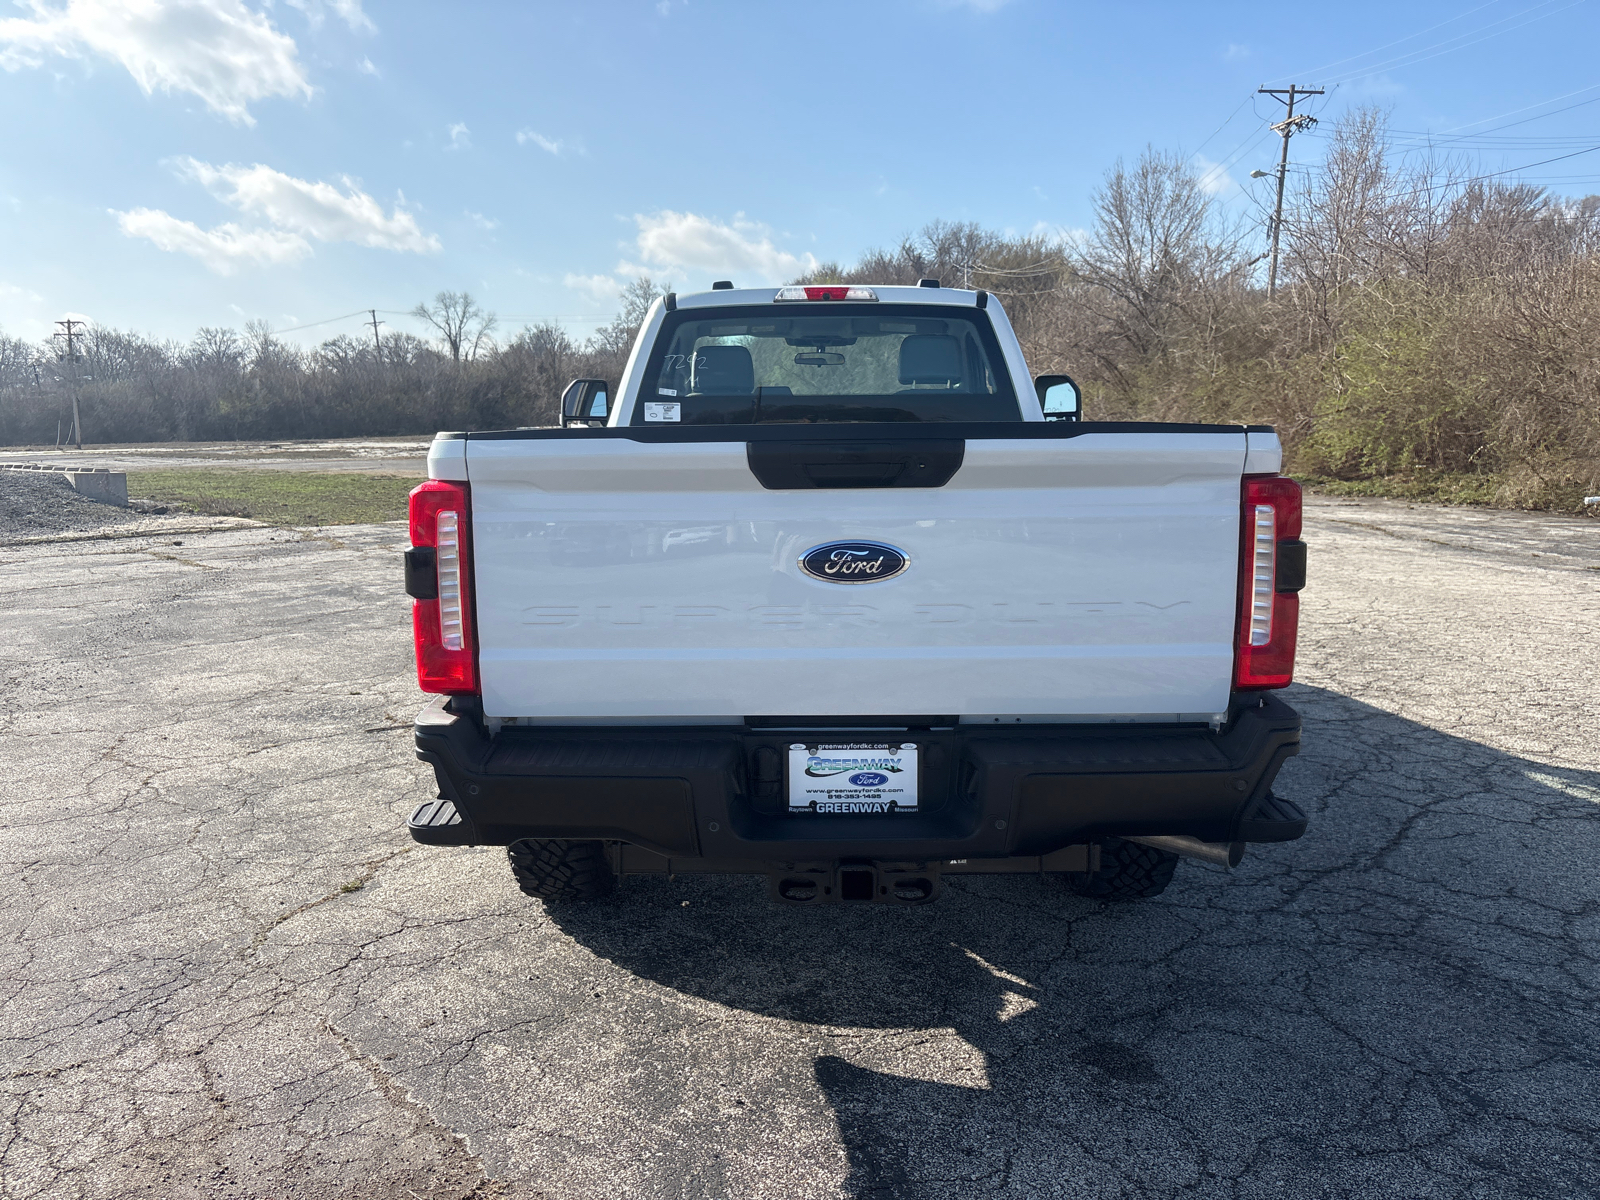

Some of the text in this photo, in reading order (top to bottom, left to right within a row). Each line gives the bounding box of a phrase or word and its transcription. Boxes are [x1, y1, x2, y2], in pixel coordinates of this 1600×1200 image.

[824, 549, 884, 574] Ford
[807, 756, 902, 771] GREENWAY
[856, 773, 880, 785] Ford
[816, 803, 890, 813] GREENWAY
